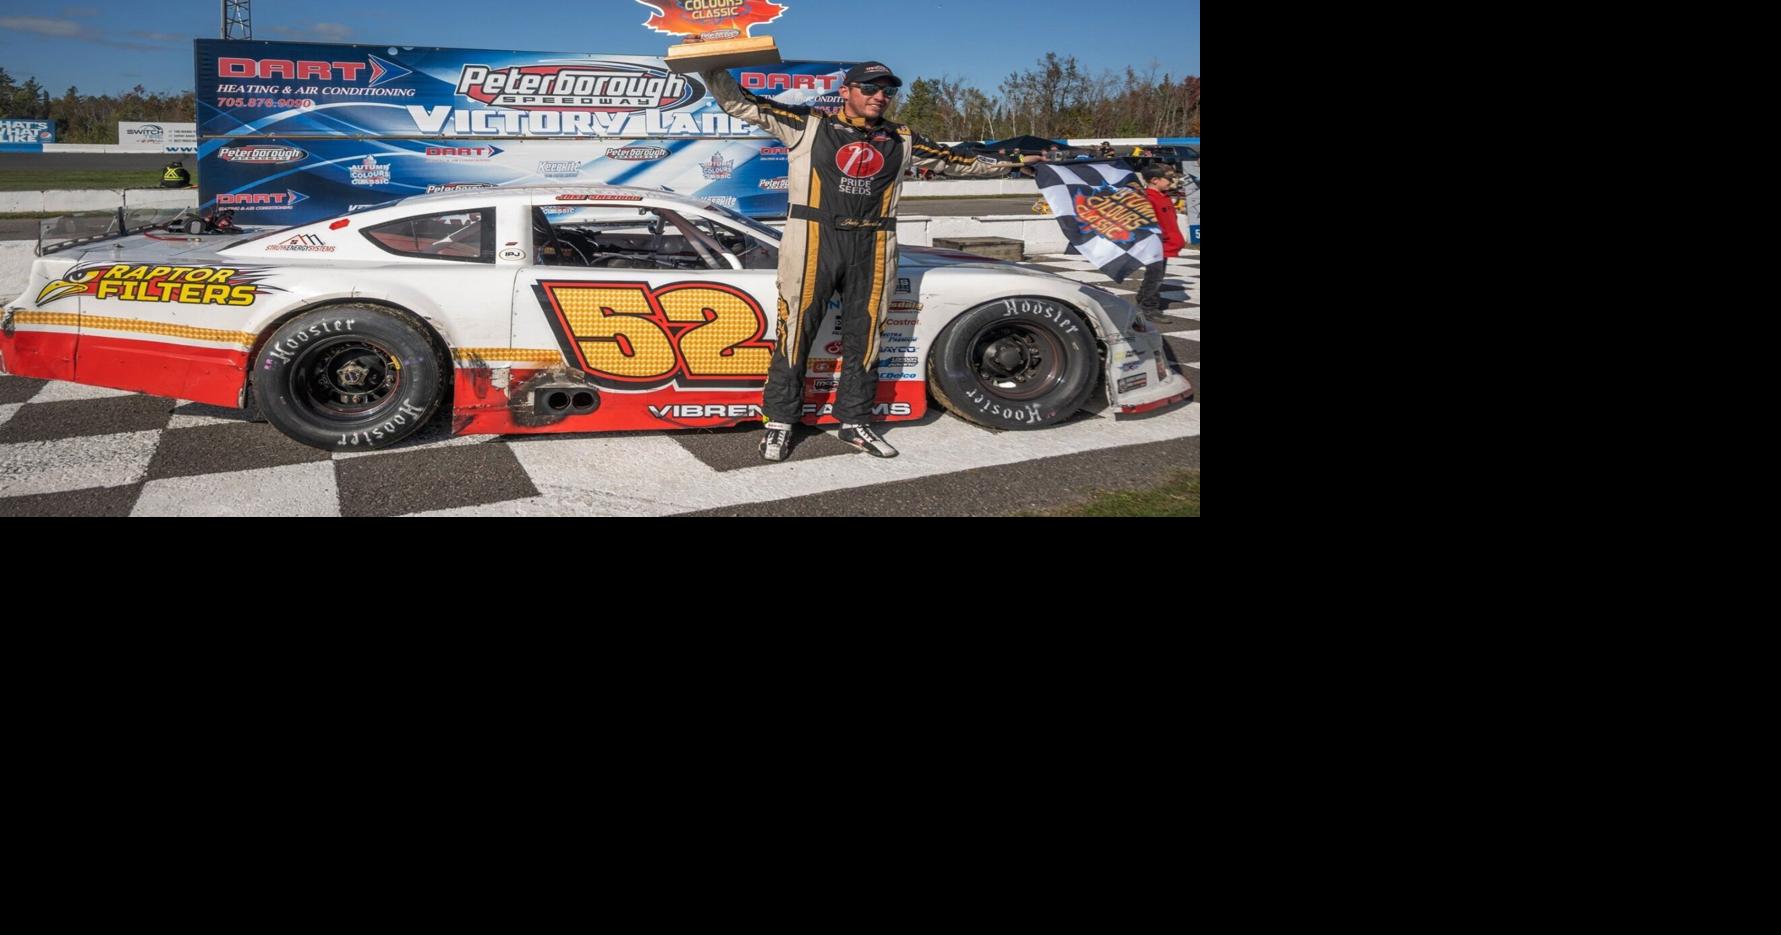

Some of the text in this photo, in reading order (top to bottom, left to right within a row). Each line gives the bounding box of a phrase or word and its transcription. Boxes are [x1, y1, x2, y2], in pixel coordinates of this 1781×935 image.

[691, 7, 739, 20] CLASSIC
[217, 57, 366, 81] DART
[455, 64, 687, 104] Peterborough
[740, 72, 838, 90] DART
[217, 84, 416, 97] HEATING & AIR CONDITIONING
[502, 96, 651, 105] SPEEDWAY
[0, 121, 49, 130] HAT'S
[405, 105, 753, 137] VICTORY LANE
[218, 147, 301, 160] Peterborough
[425, 147, 486, 157] DART
[605, 147, 667, 159] Peterborough
[760, 147, 790, 156] DAR
[351, 170, 390, 179] COLOURS
[840, 176, 872, 188] PRIDE
[838, 184, 872, 196] SEEDS
[215, 193, 288, 204] DART
[103, 264, 236, 284] RAPTOR
[96, 280, 258, 307] FILTERS
[886, 318, 919, 327] Castrol
[1002, 298, 1080, 335] Hoosier
[541, 281, 775, 383] 52
[269, 318, 356, 365] Hoosier
[801, 402, 912, 417] FAMS
[966, 388, 1043, 425] Hoosier
[337, 398, 424, 446] Hoosier
